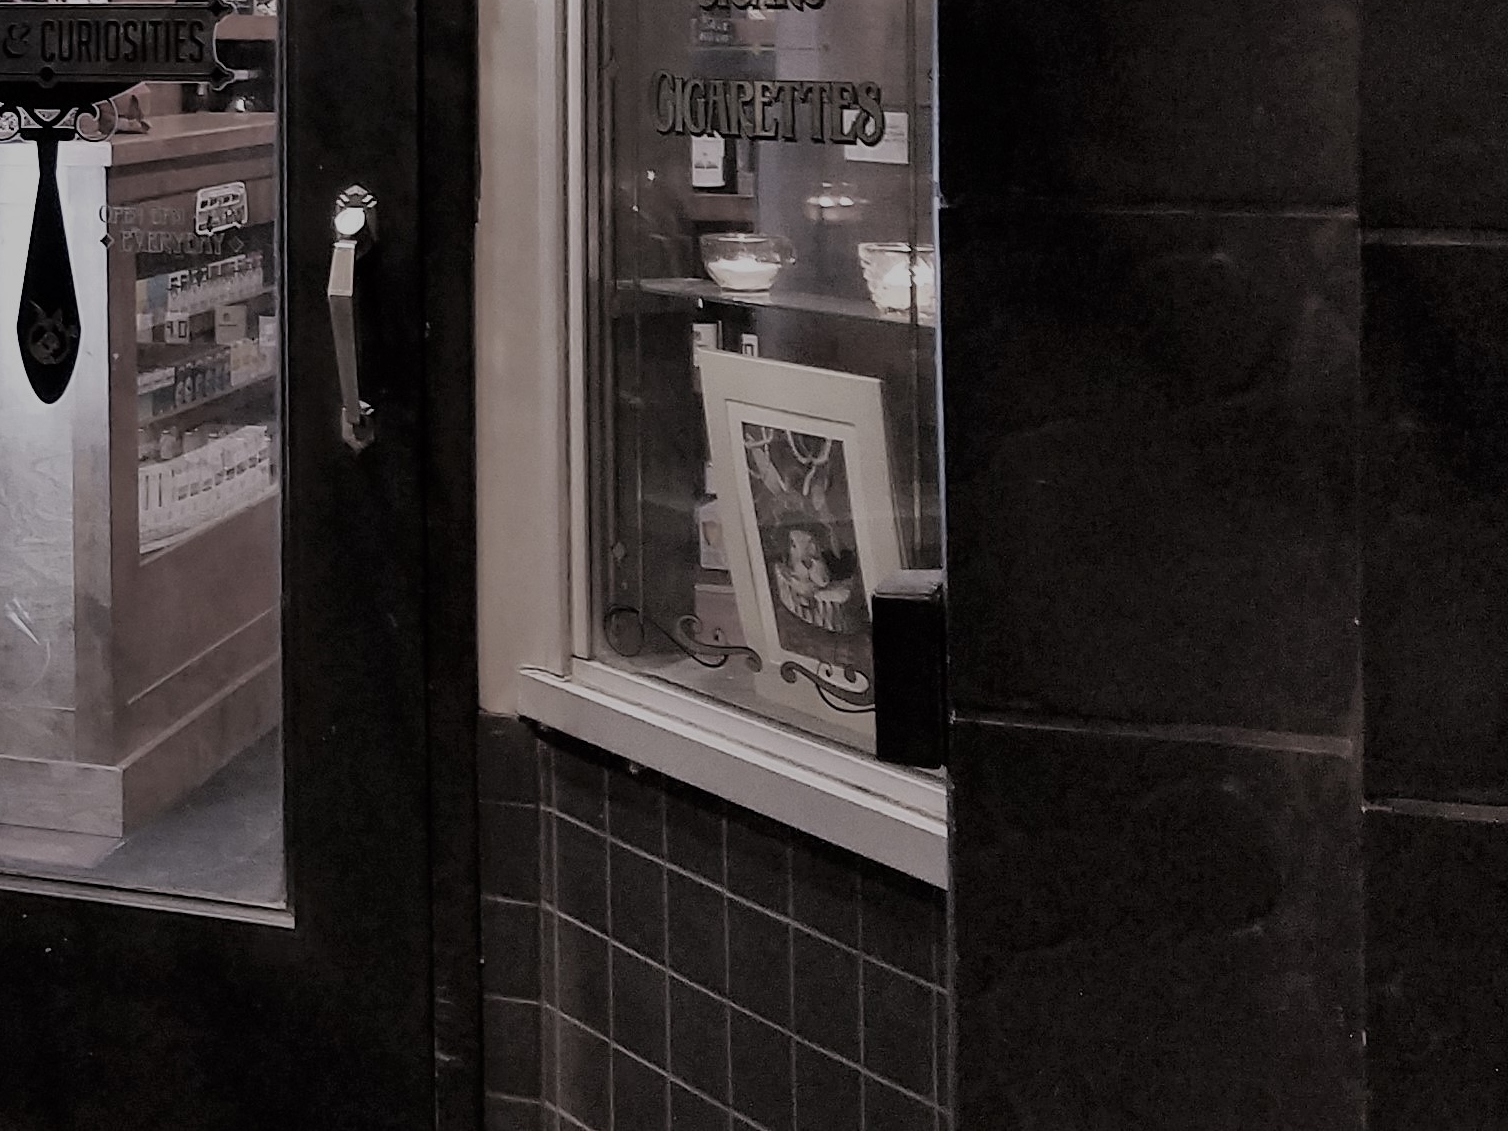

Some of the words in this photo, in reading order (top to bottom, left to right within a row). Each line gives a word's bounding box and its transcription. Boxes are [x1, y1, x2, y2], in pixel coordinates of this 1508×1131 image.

[2, 21, 33, 60] &
[40, 19, 205, 64] CURIOSITIES
[654, 70, 886, 148] CIGARETTES
